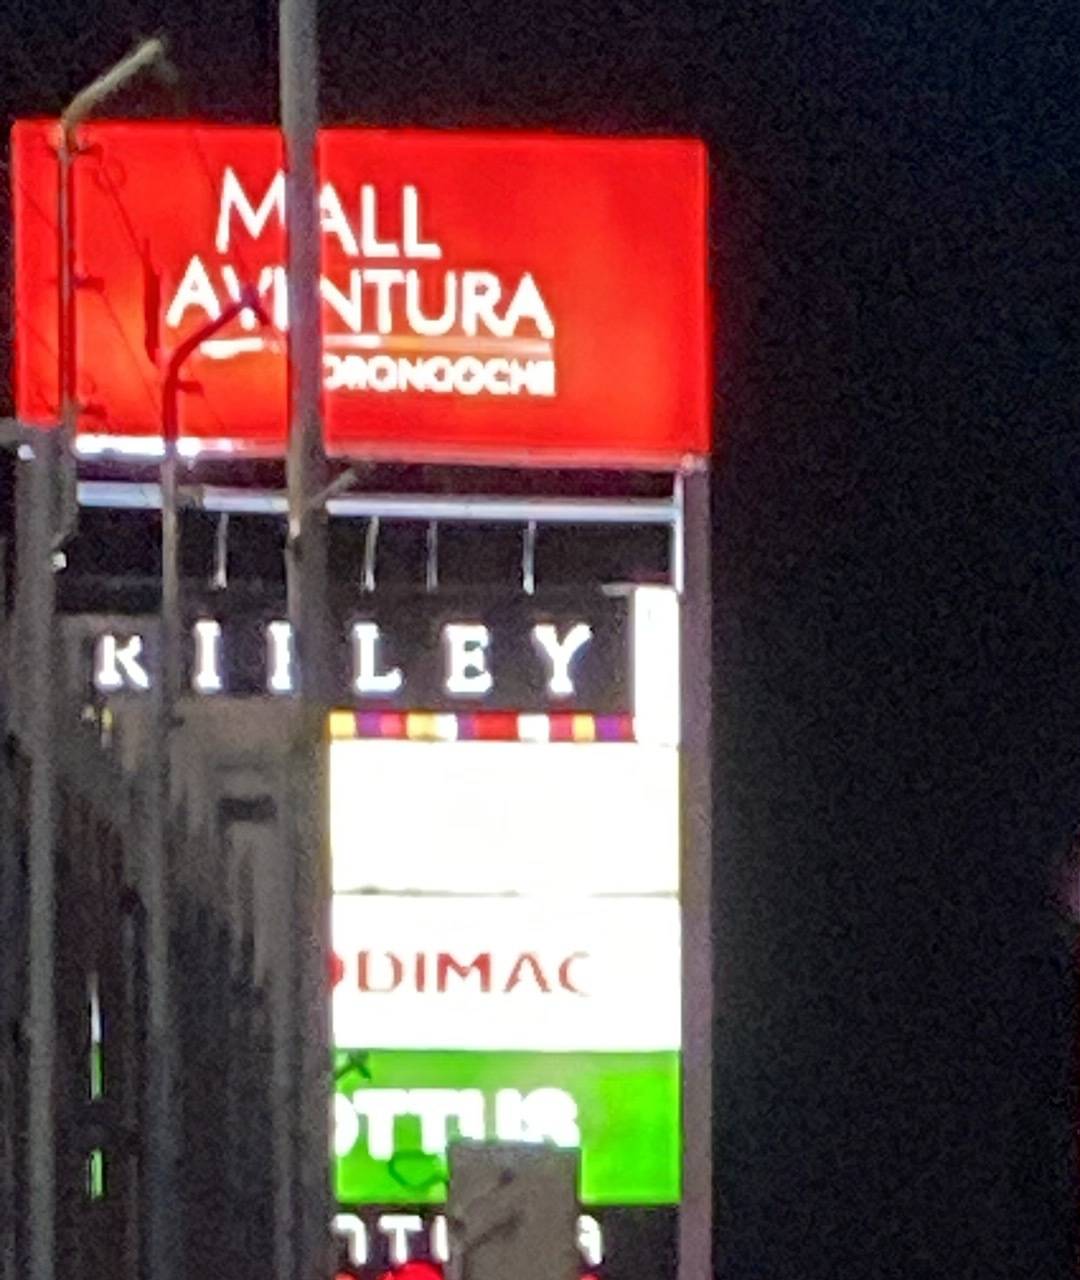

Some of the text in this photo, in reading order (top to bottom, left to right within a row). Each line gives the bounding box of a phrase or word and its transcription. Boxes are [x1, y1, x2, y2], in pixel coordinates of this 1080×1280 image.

[215, 166, 441, 260] MALL
[321, 354, 556, 397] ORONGOCHE
[331, 950, 591, 997] DIMAC
